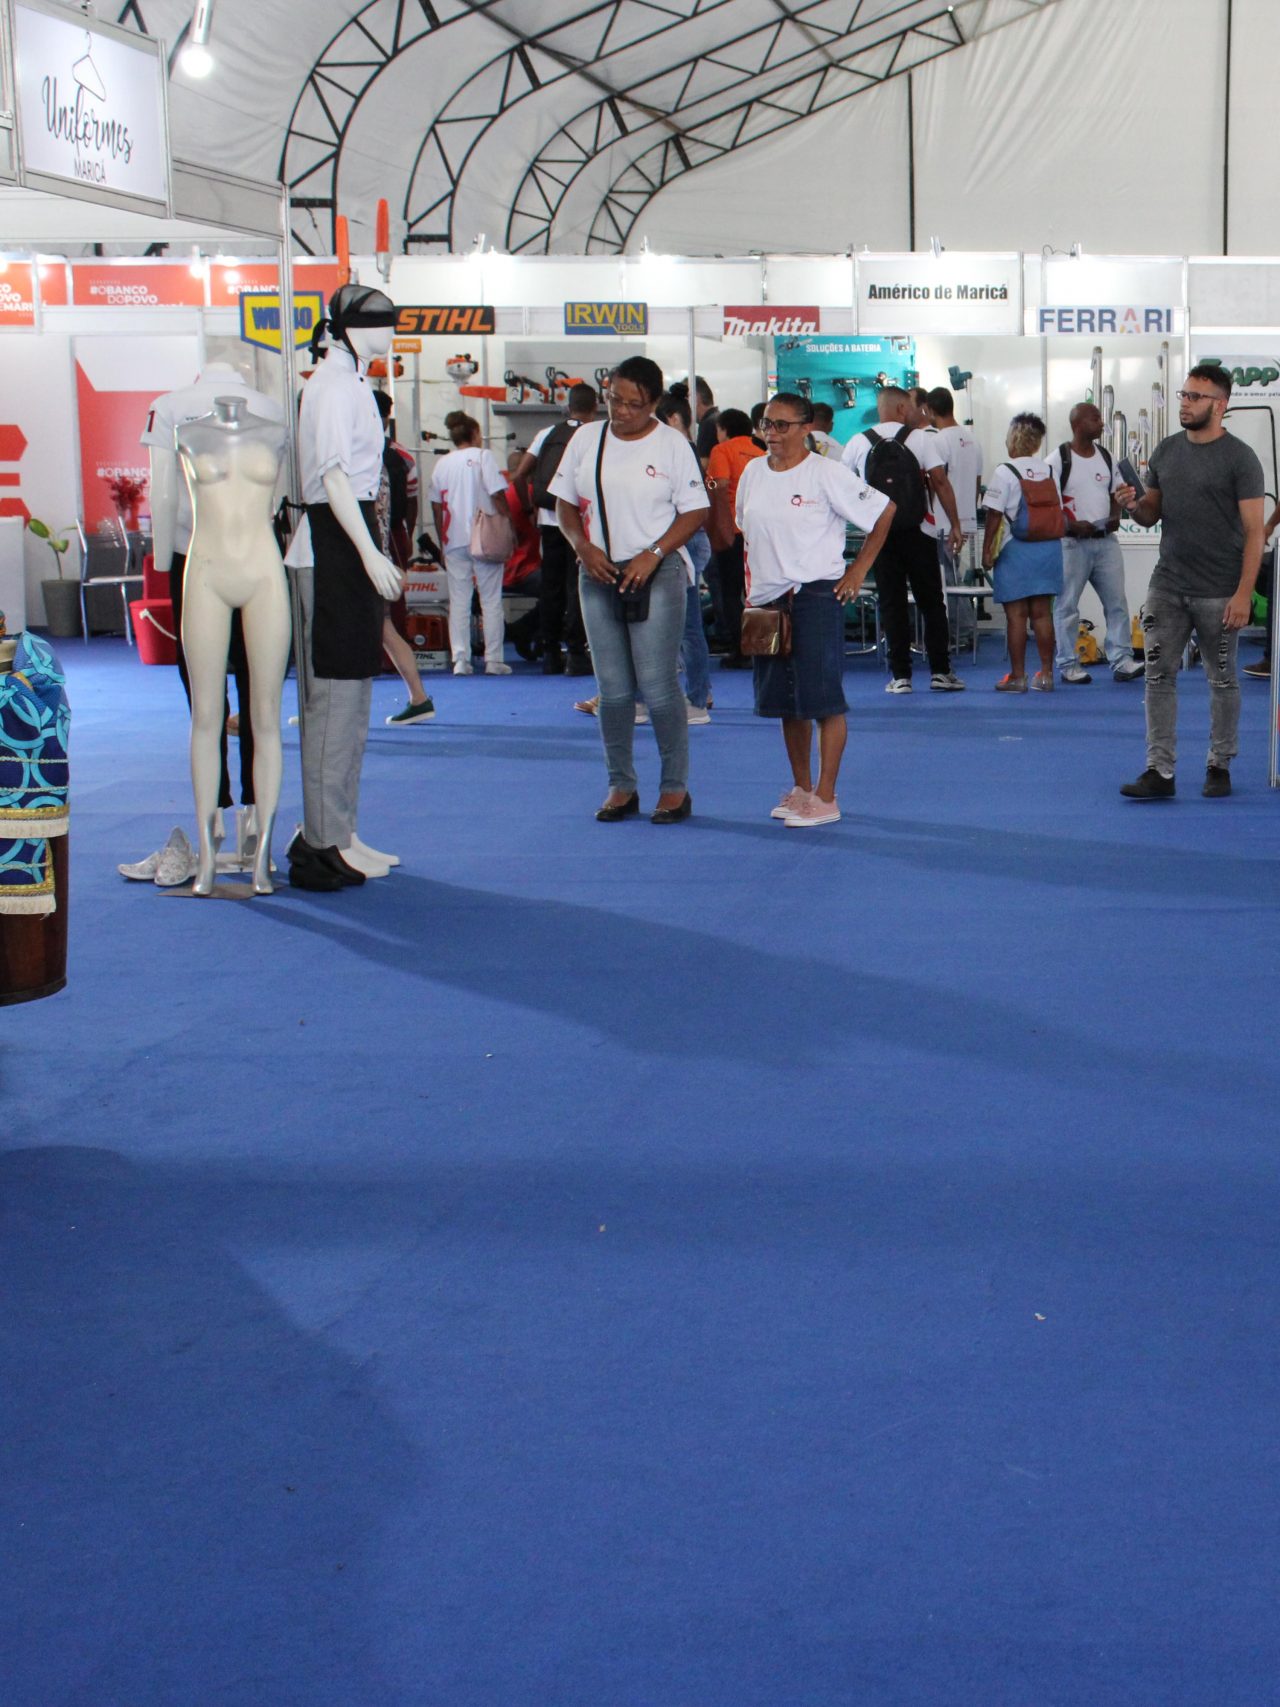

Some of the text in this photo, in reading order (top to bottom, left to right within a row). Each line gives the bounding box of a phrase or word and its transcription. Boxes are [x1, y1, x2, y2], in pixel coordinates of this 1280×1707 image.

[42, 75, 134, 164] Uniformes
[107, 294, 158, 304] DOPOVO
[868, 283, 1009, 300] Américo de Maricá
[395, 308, 492, 332] STIHL
[566, 303, 645, 324] IRWIN
[1039, 307, 1172, 334] FERRARI
[617, 323, 645, 332] TOOLS
[805, 342, 882, 354] SOLUÇÕES A BATERIA
